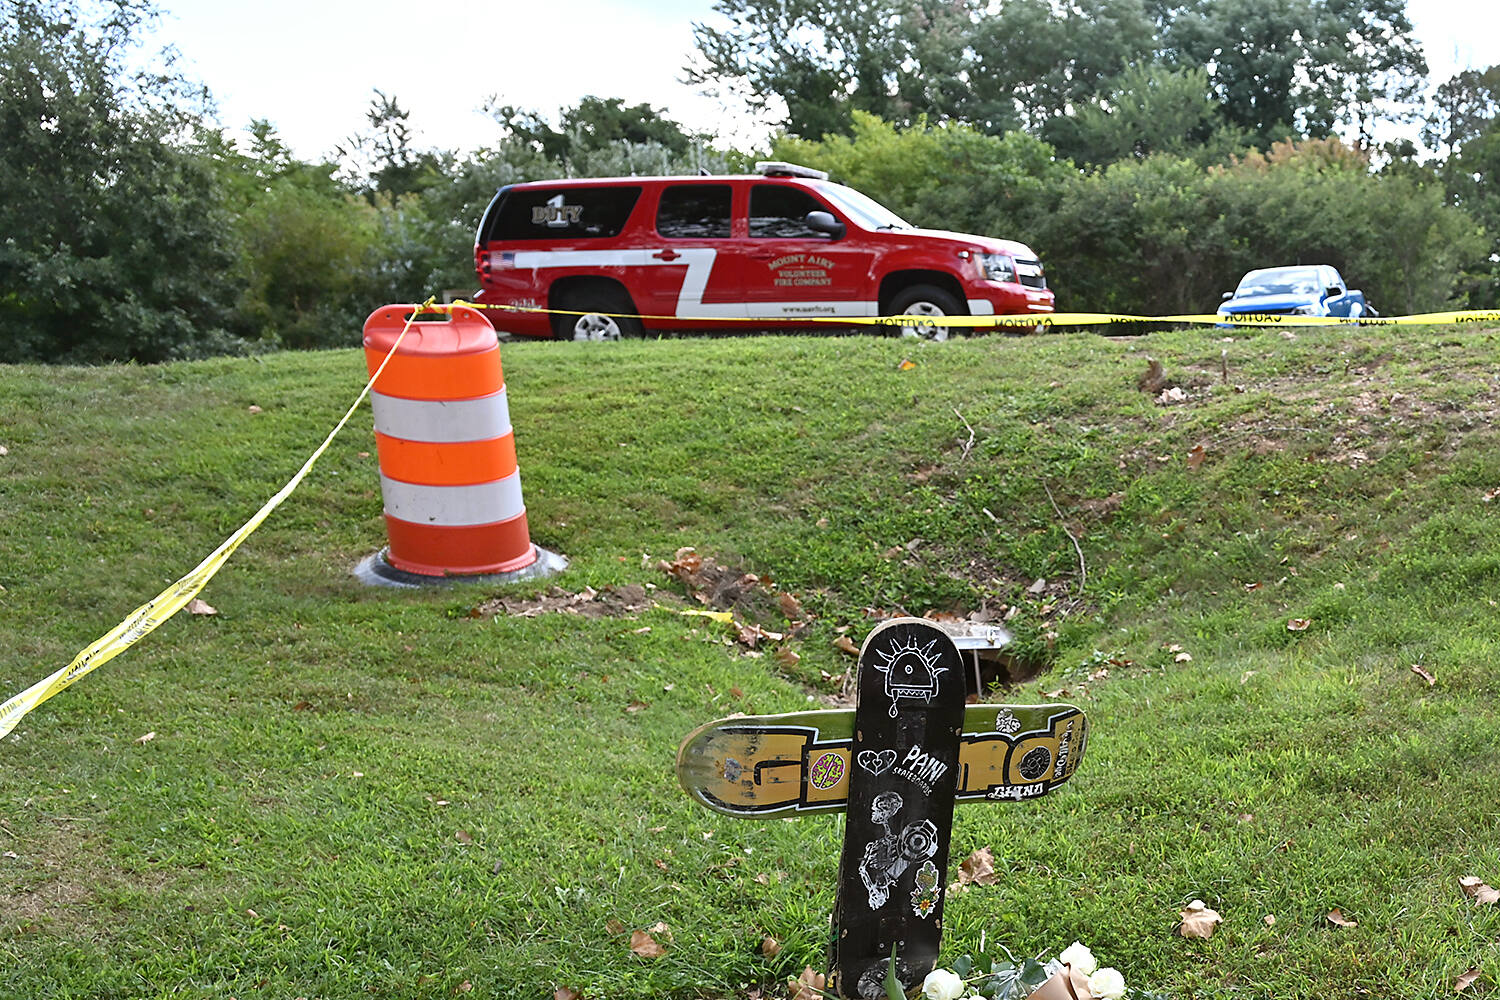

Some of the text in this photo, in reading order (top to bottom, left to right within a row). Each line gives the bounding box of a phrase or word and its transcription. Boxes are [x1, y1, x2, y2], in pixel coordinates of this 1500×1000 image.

[531, 205, 584, 224] DUTY
[768, 254, 836, 271] MOUNT AIRY
[778, 270, 827, 278] VOLUNTEER
[774, 278, 832, 287] FIRE COMPANY
